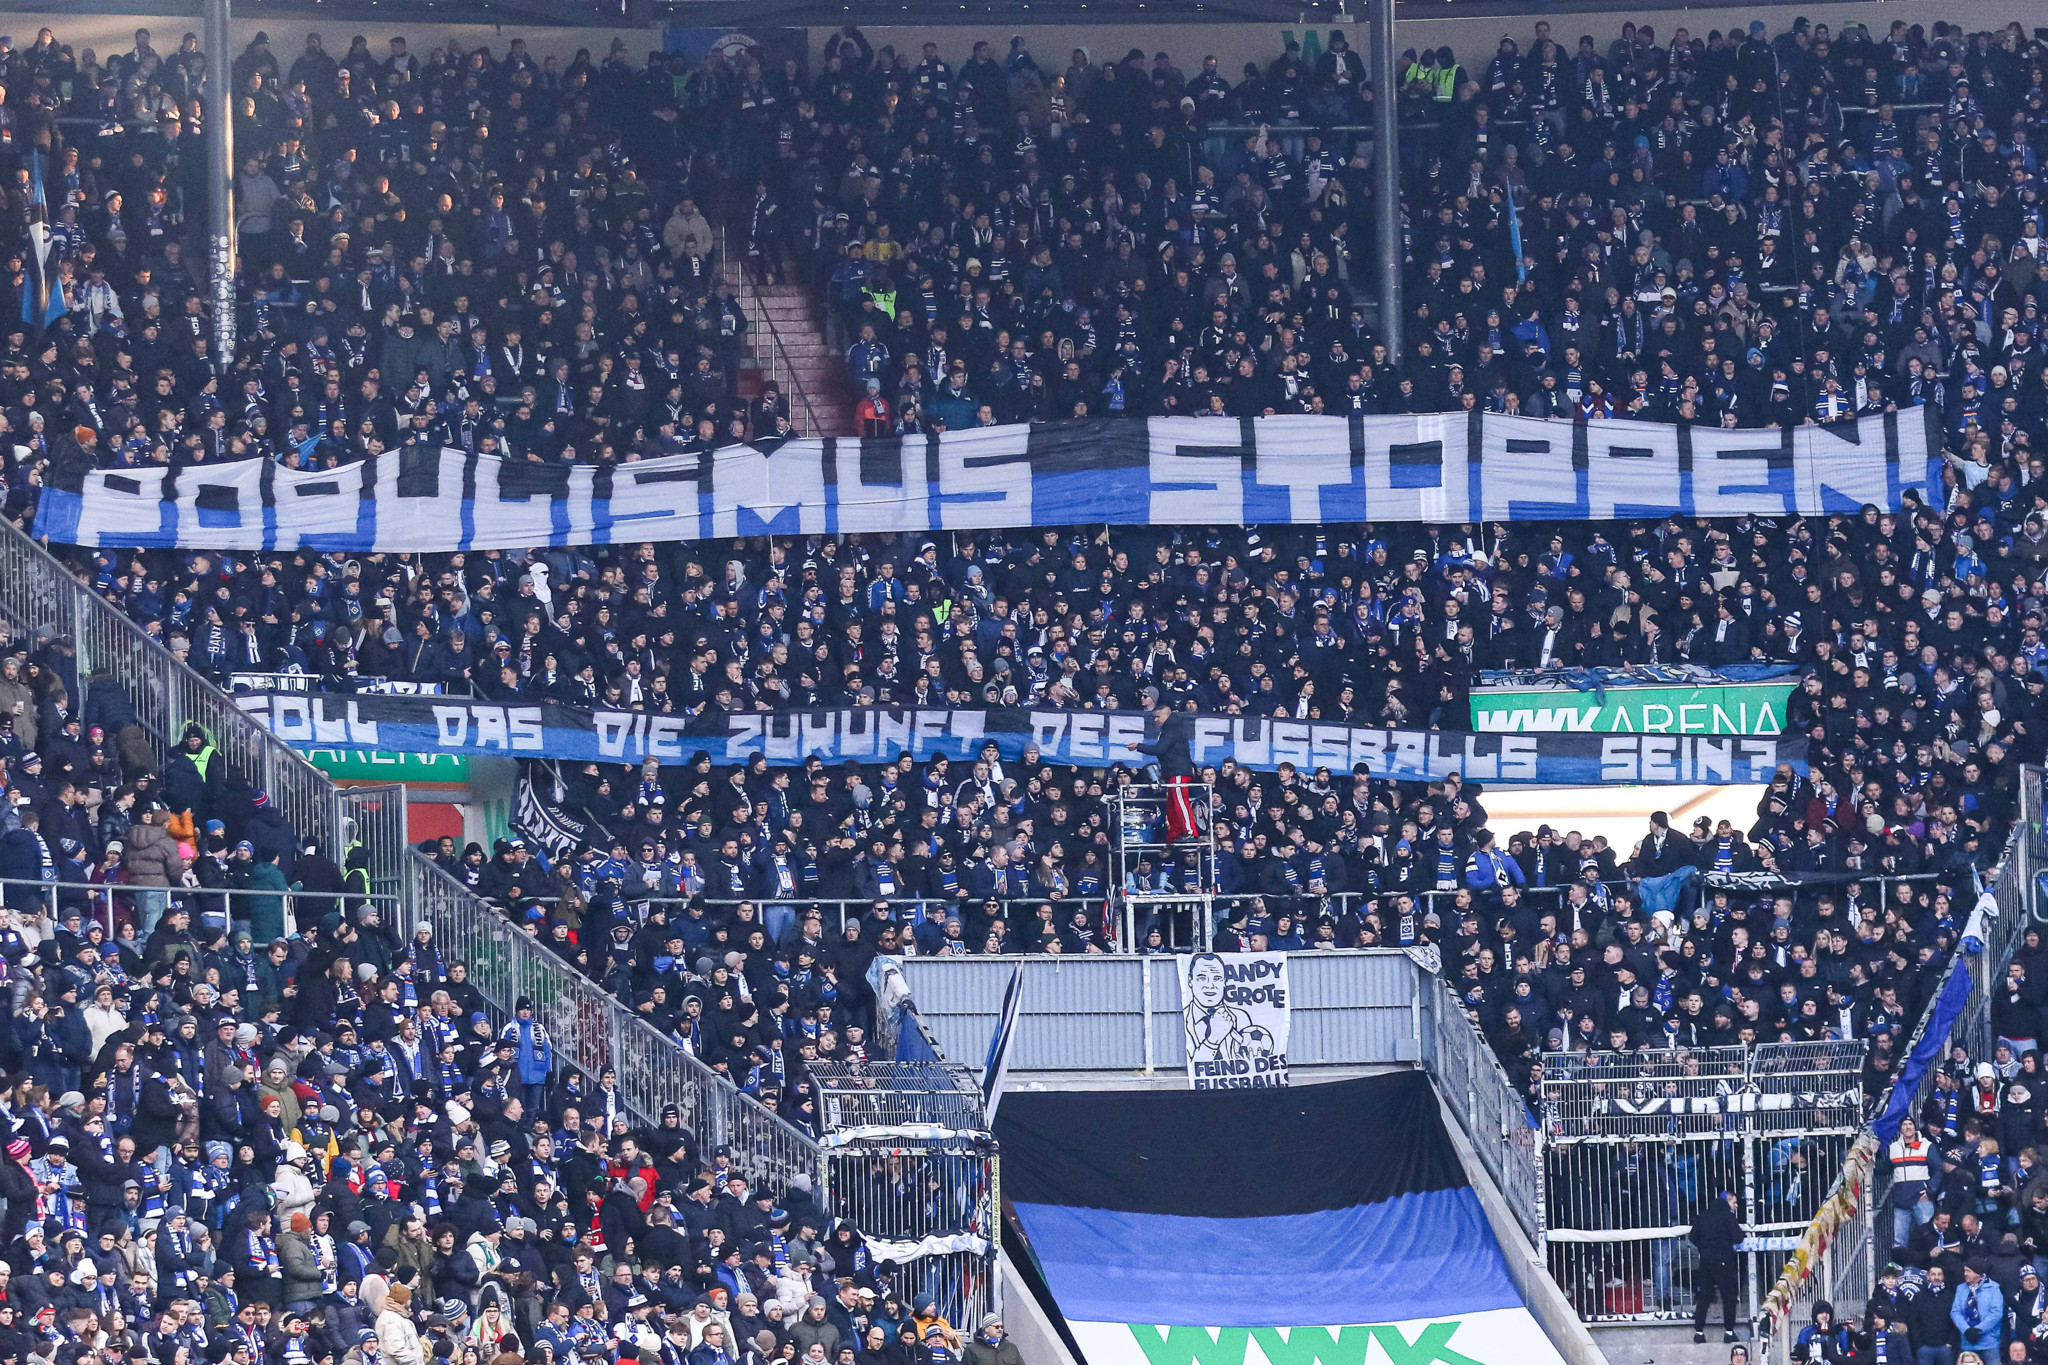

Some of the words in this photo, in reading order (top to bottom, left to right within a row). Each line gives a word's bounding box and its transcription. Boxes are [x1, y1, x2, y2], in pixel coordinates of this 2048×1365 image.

[76, 423, 1033, 553] POPULISMUS
[1147, 404, 1930, 525] STOPPEN!
[1477, 706, 1602, 732] WWK
[431, 703, 543, 751] DAS
[592, 711, 686, 757] DIE
[726, 710, 987, 758] ZUKUNFT
[1029, 711, 1145, 761] DES
[1193, 718, 1538, 780] FUSSBALLS
[1601, 736, 1778, 781] SEIN?
[1224, 960, 1284, 982] ANDY
[1223, 984, 1286, 1008] GROTE
[1195, 1060, 1250, 1077] FEIND
[1255, 1054, 1288, 1072] DES
[1126, 1321, 1487, 1365] WWK
